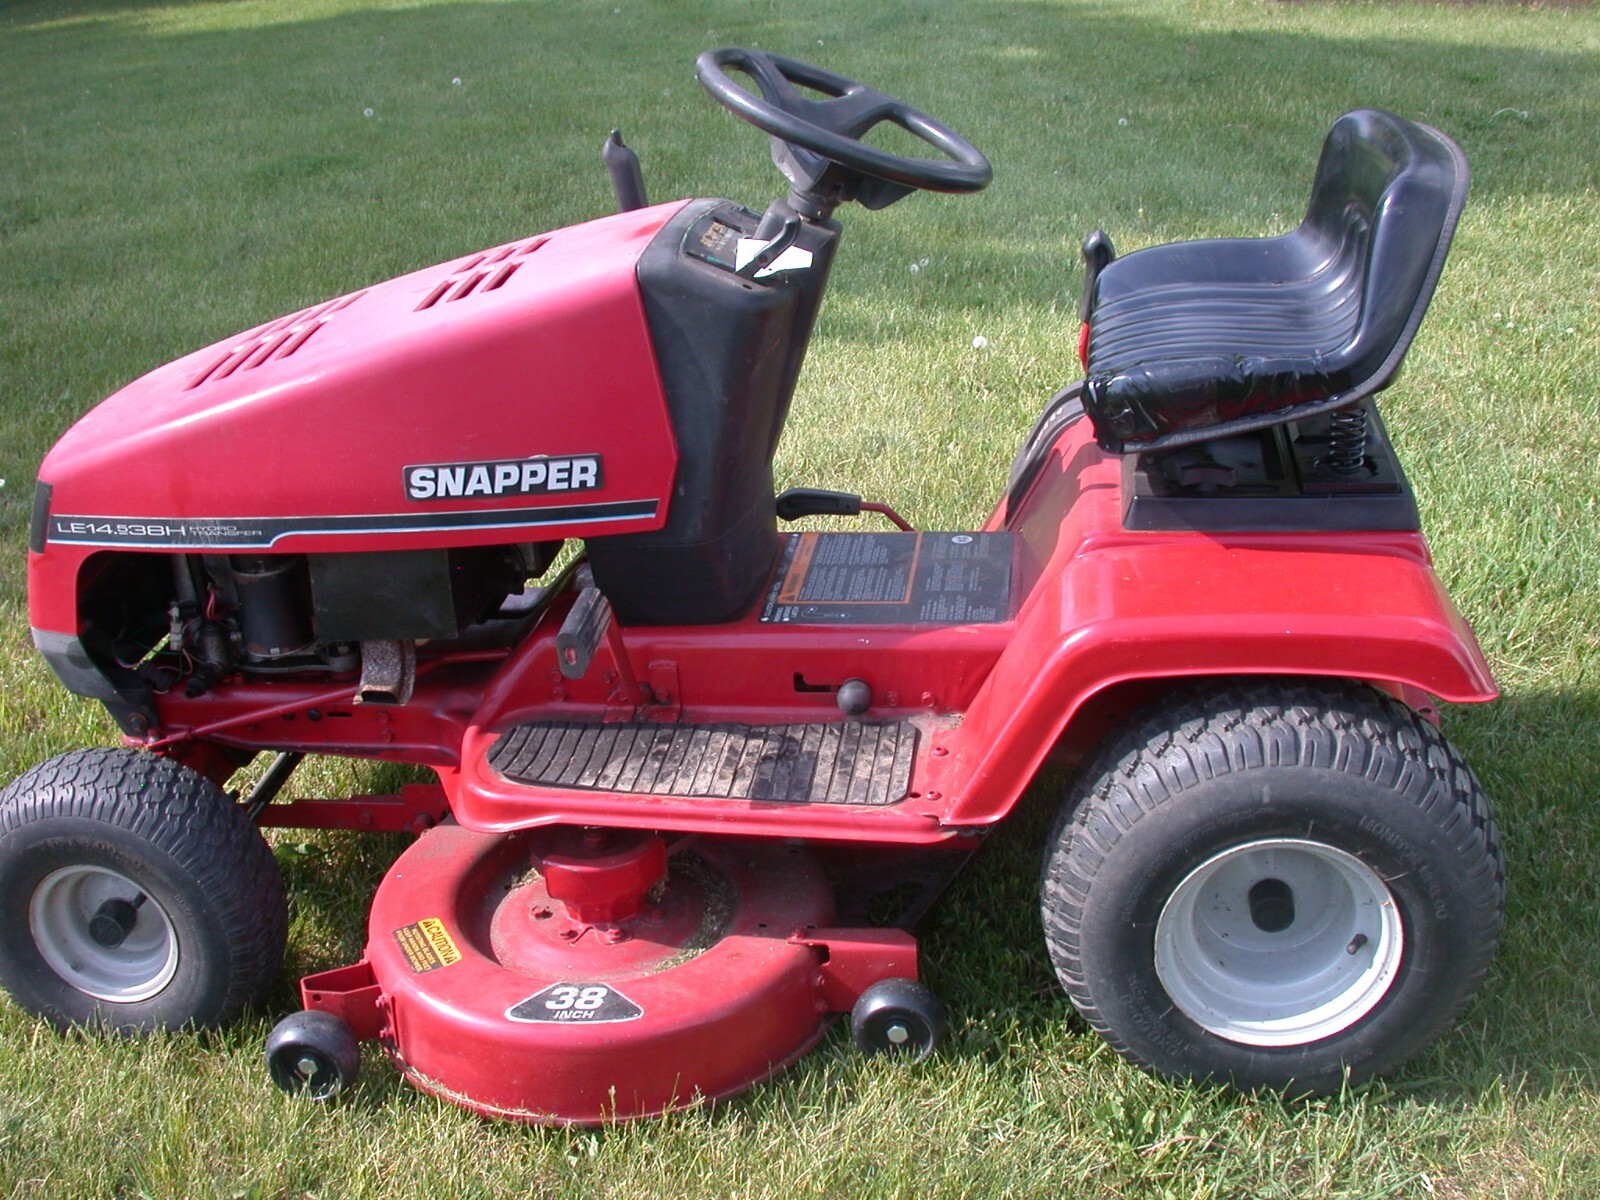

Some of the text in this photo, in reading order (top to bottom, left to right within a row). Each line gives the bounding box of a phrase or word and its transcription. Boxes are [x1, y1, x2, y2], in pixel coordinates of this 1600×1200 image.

[409, 457, 597, 498] SNAPPER
[427, 926, 455, 958] CAUTION
[545, 986, 608, 1010] 38
[553, 1010, 595, 1019] INCH
